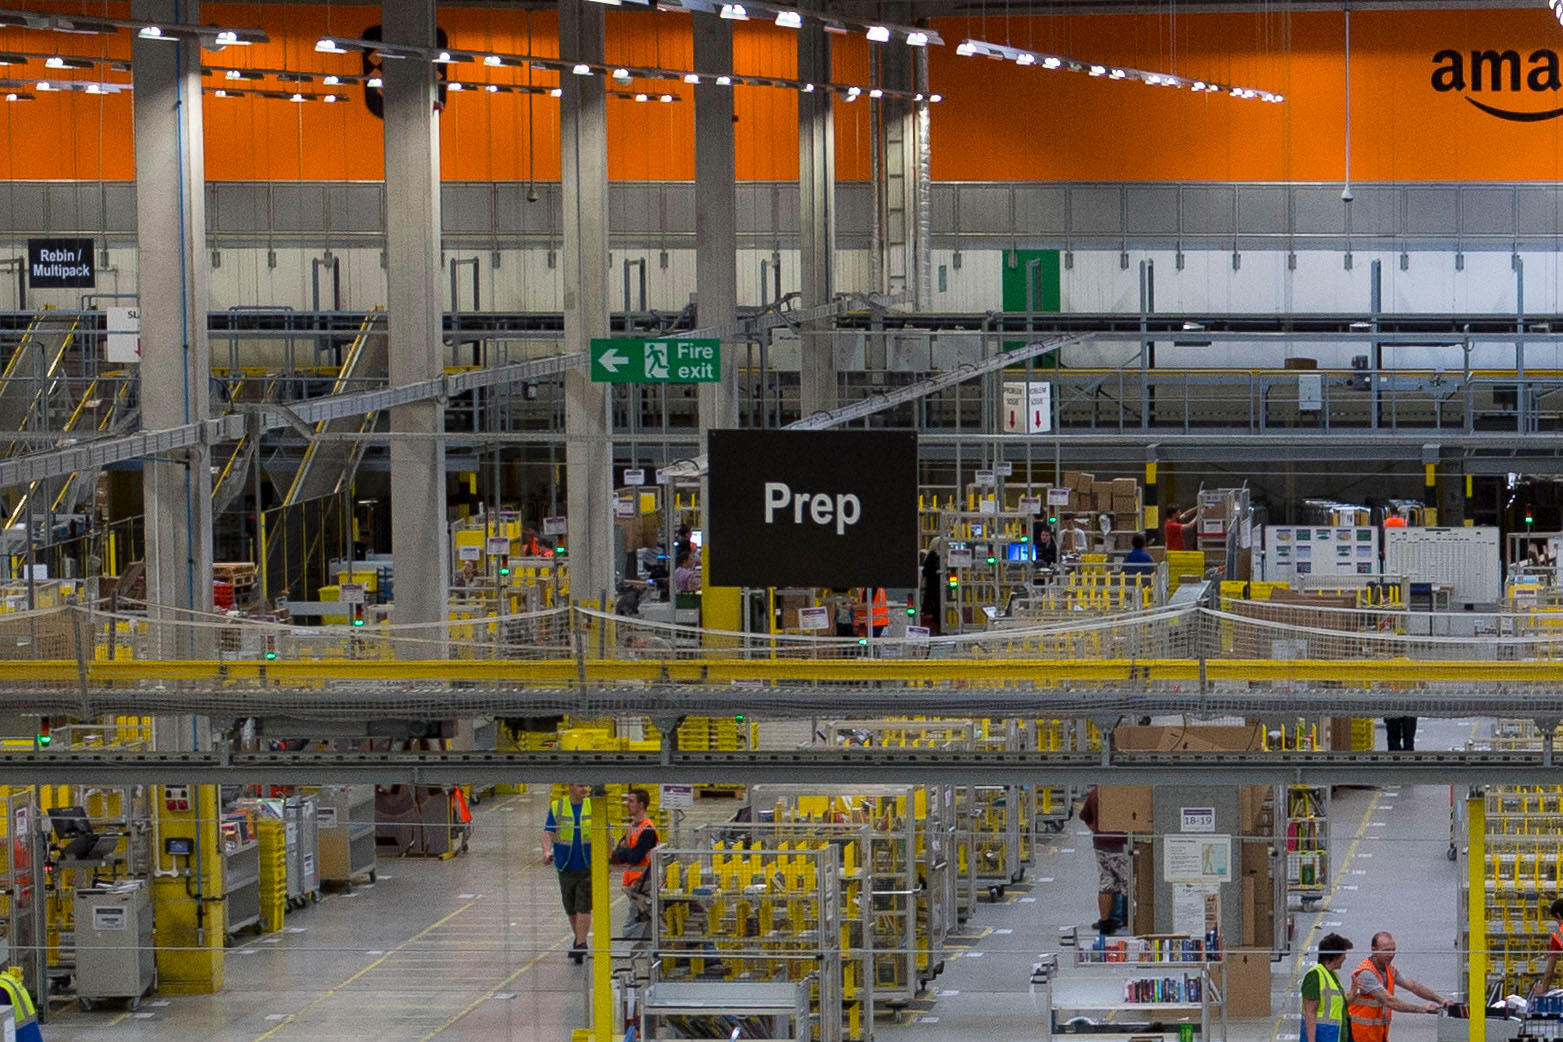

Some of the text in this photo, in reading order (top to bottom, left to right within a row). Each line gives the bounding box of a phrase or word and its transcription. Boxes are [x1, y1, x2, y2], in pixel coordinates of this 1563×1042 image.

[40, 248, 83, 262] Rebin /
[33, 263, 90, 279] Multipack
[677, 343, 714, 360] Fire
[678, 362, 714, 380] exit
[764, 482, 862, 535] Prep
[1184, 816, 1212, 826] 18-19
